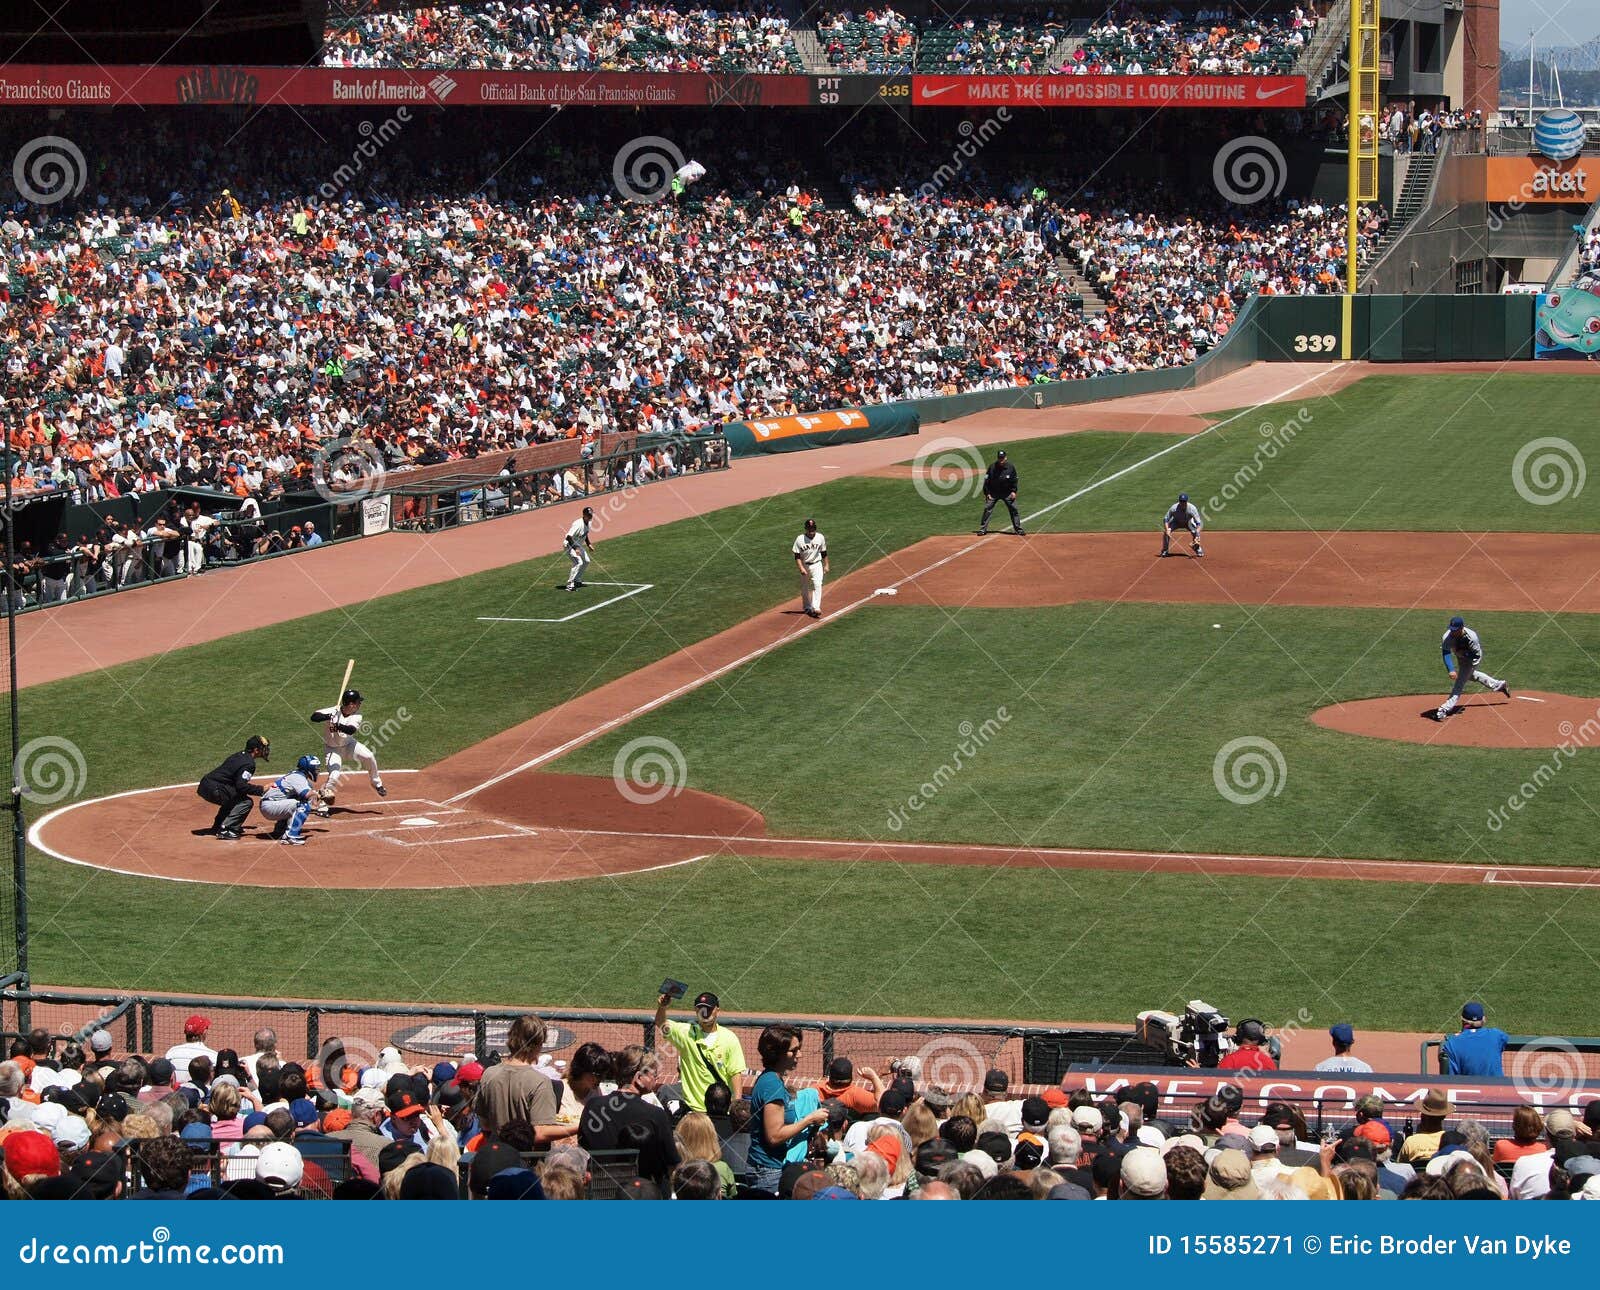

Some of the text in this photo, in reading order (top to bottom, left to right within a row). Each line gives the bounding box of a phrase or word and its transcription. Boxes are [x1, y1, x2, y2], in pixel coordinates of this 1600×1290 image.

[0, 79, 111, 99] Francisco Giants
[333, 80, 426, 100] Bank of America
[480, 83, 676, 101] Official Bank of the San Francisco Giants
[818, 78, 841, 90] PIT
[879, 84, 909, 97] 3:35
[967, 83, 1246, 100] MAKE THE IMPOSSIBLE LOOK ROUTINE
[819, 92, 839, 104] SD
[1532, 168, 1587, 192] at&t
[1294, 335, 1337, 353] 339
